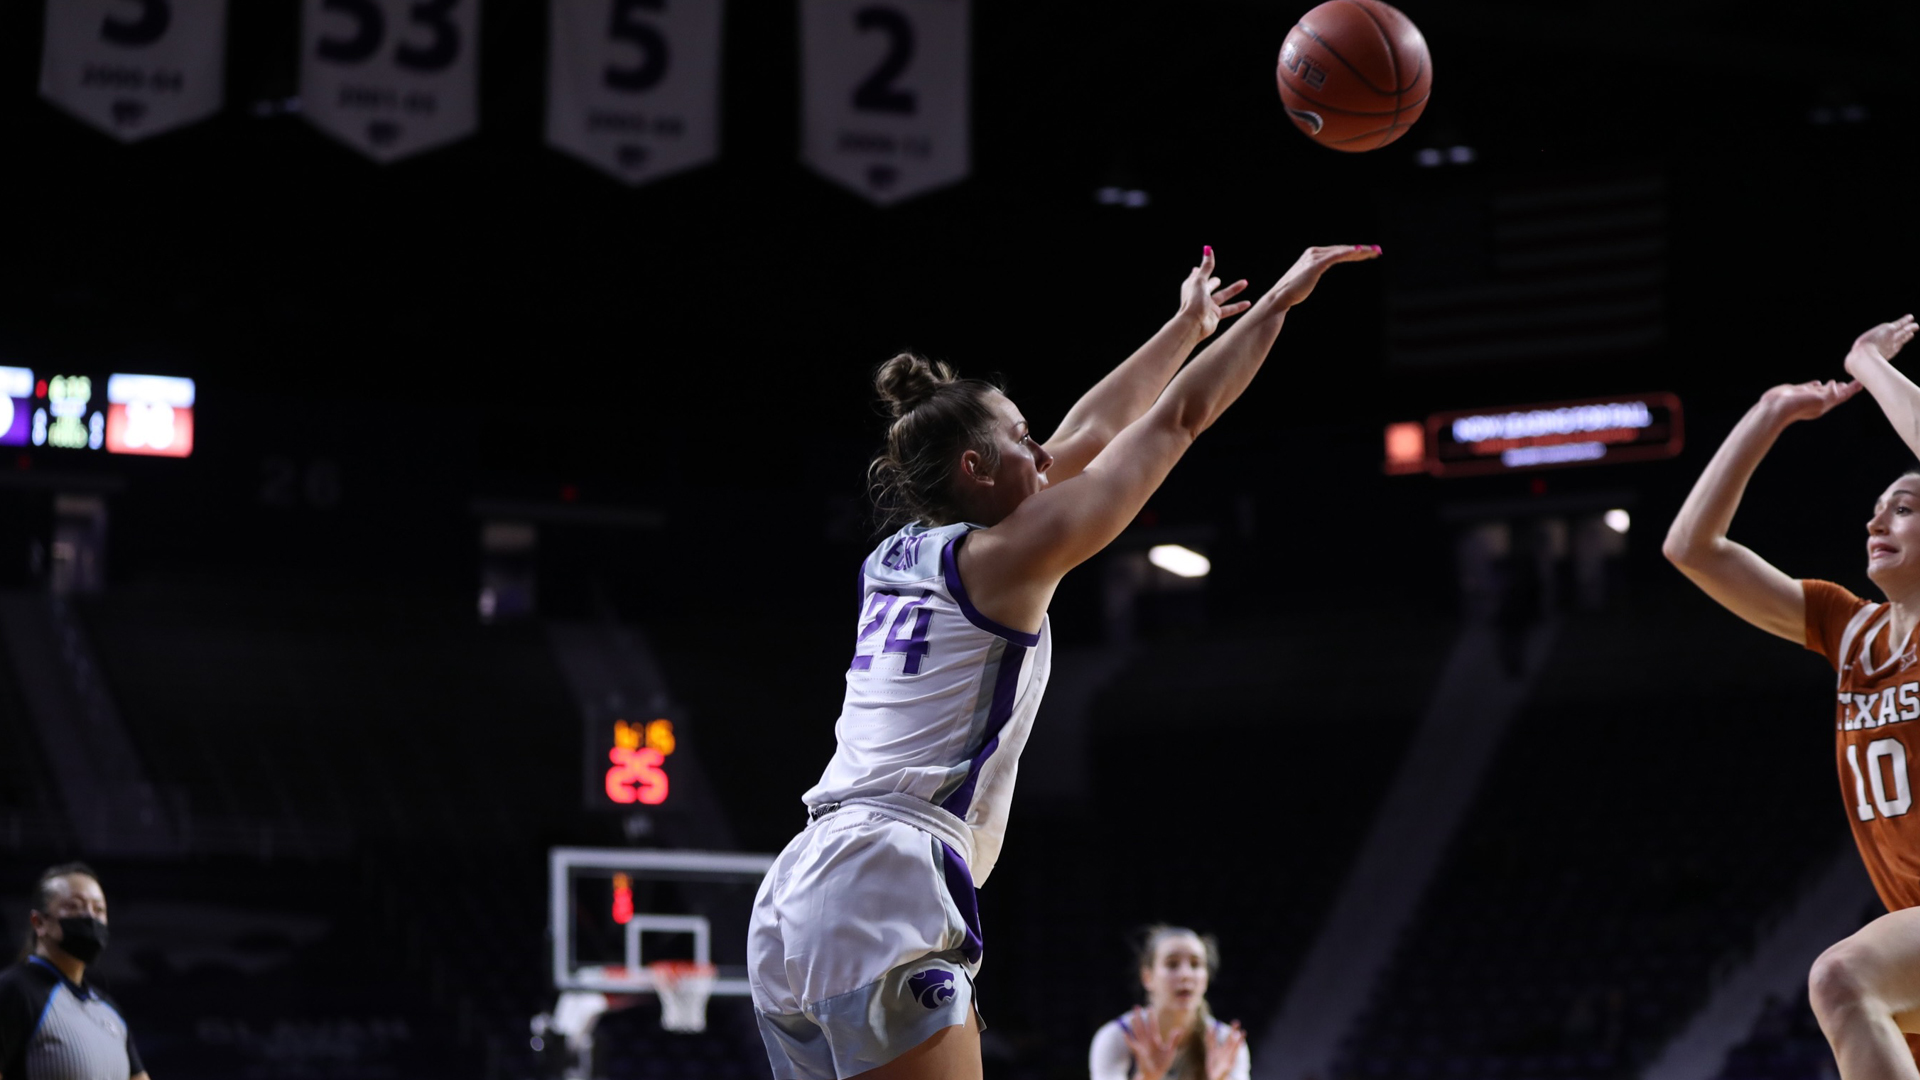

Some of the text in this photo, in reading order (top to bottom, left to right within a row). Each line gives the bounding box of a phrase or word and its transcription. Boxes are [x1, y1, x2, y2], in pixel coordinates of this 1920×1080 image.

[856, 8, 915, 116] 2
[851, 590, 934, 675] 24
[1847, 738, 1913, 821] 10
